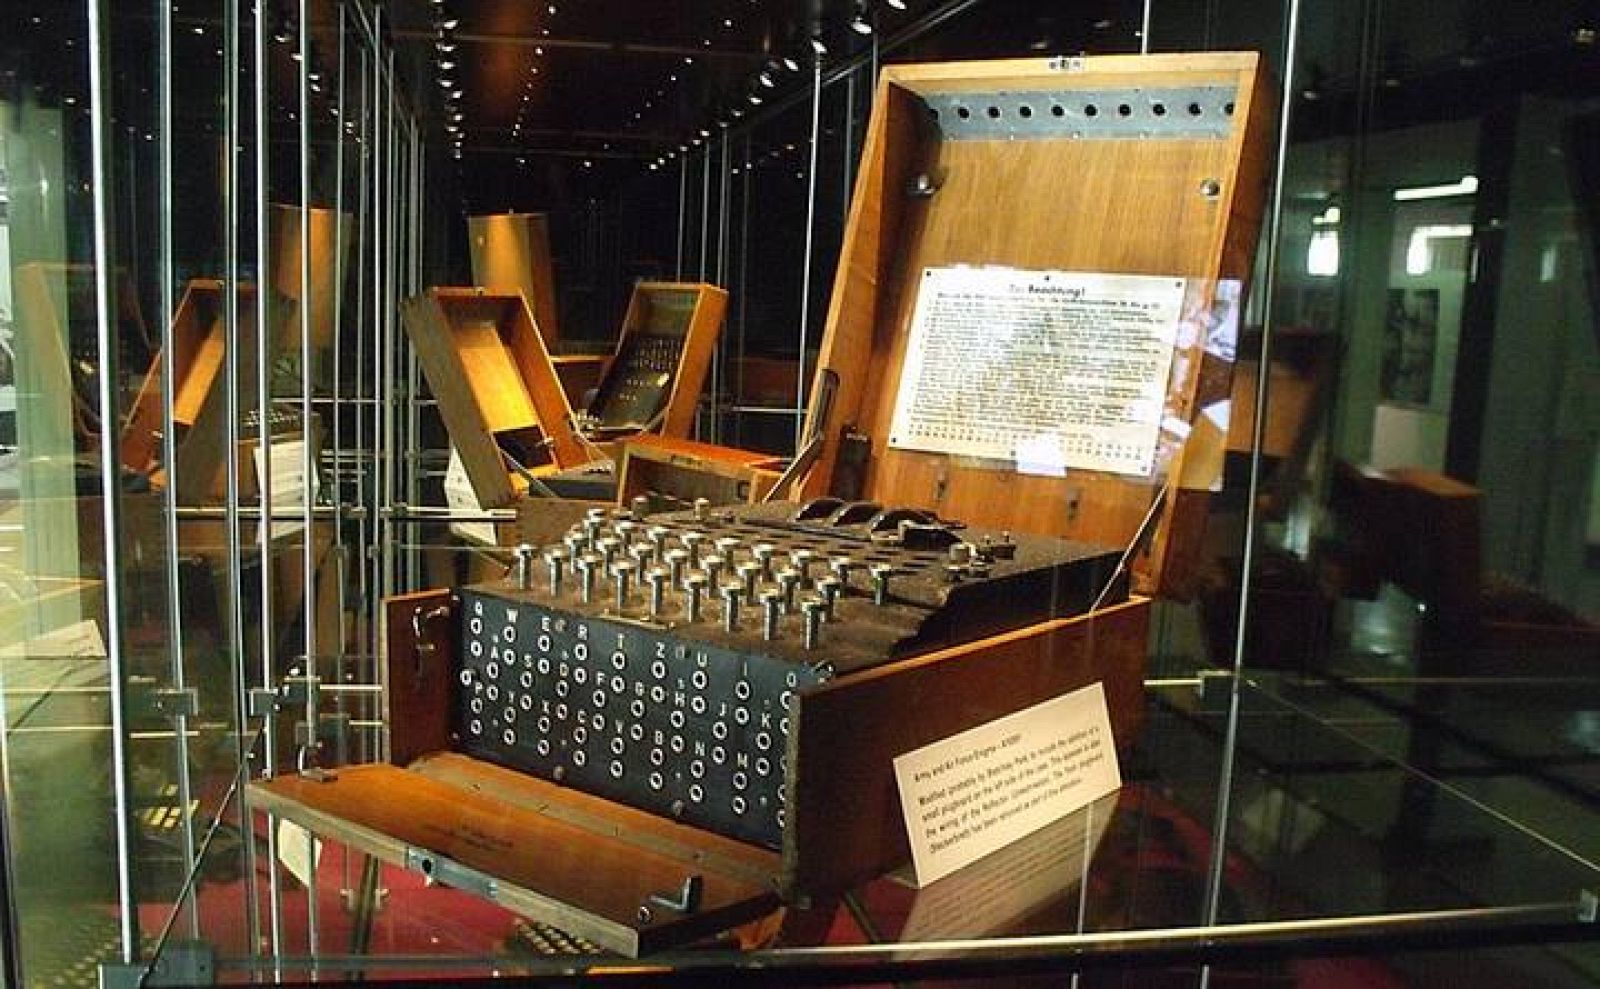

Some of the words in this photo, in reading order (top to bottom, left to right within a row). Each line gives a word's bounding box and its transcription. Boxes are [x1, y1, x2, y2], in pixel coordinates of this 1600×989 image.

[542, 616, 550, 631] E
[579, 624, 588, 640] R
[656, 642, 665, 658] Z
[697, 652, 707, 667] U
[597, 672, 606, 685] F
[720, 702, 727, 716] J
[761, 712, 771, 728] K
[577, 710, 586, 723] C
[655, 730, 663, 745] B
